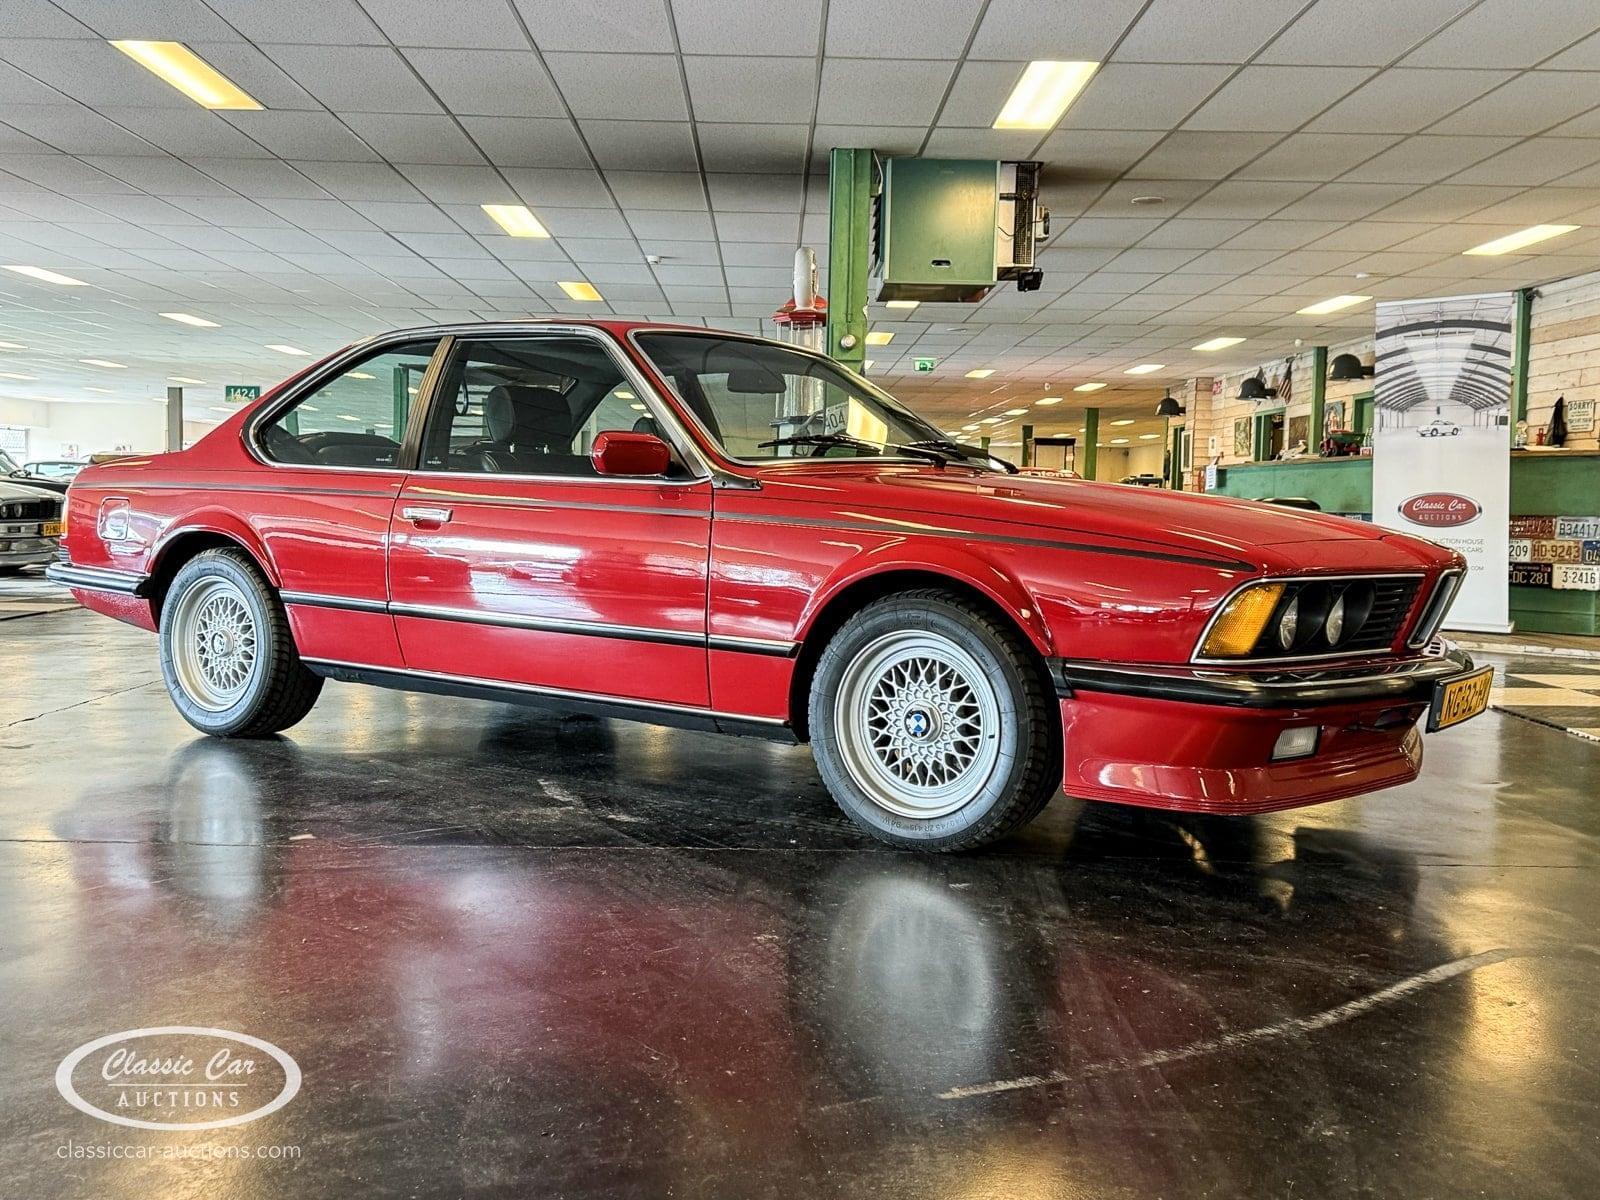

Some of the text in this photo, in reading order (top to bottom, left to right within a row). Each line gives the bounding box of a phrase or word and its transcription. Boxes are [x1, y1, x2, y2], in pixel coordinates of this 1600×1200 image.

[230, 388, 256, 400] 1424
[1413, 499, 1467, 511] Classic Car
[1418, 513, 1462, 521] AUCTIONS
[1532, 544, 1580, 559] HD-9243
[1530, 571, 1550, 585] 281
